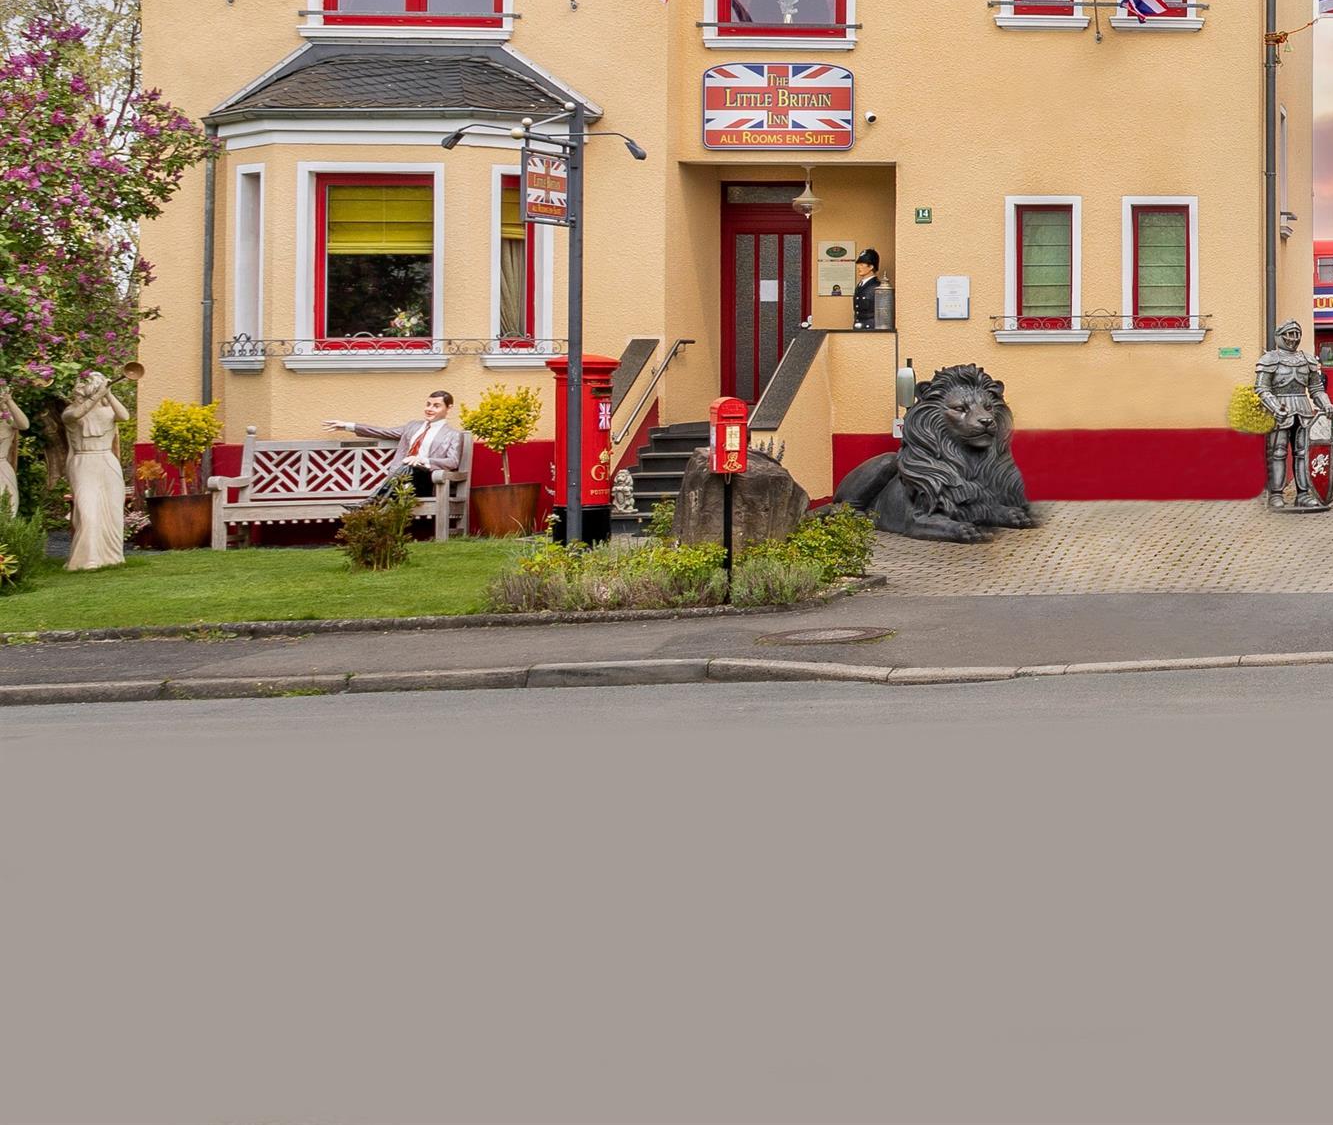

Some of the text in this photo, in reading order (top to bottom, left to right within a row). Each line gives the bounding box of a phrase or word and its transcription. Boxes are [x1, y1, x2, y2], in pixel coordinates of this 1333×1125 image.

[768, 74, 789, 86] THE
[725, 88, 832, 107] LITTLE BRITAIN
[768, 111, 789, 125] INN
[720, 135, 739, 144] ALL
[742, 132, 783, 144] ROOMS
[919, 209, 928, 218] 14
